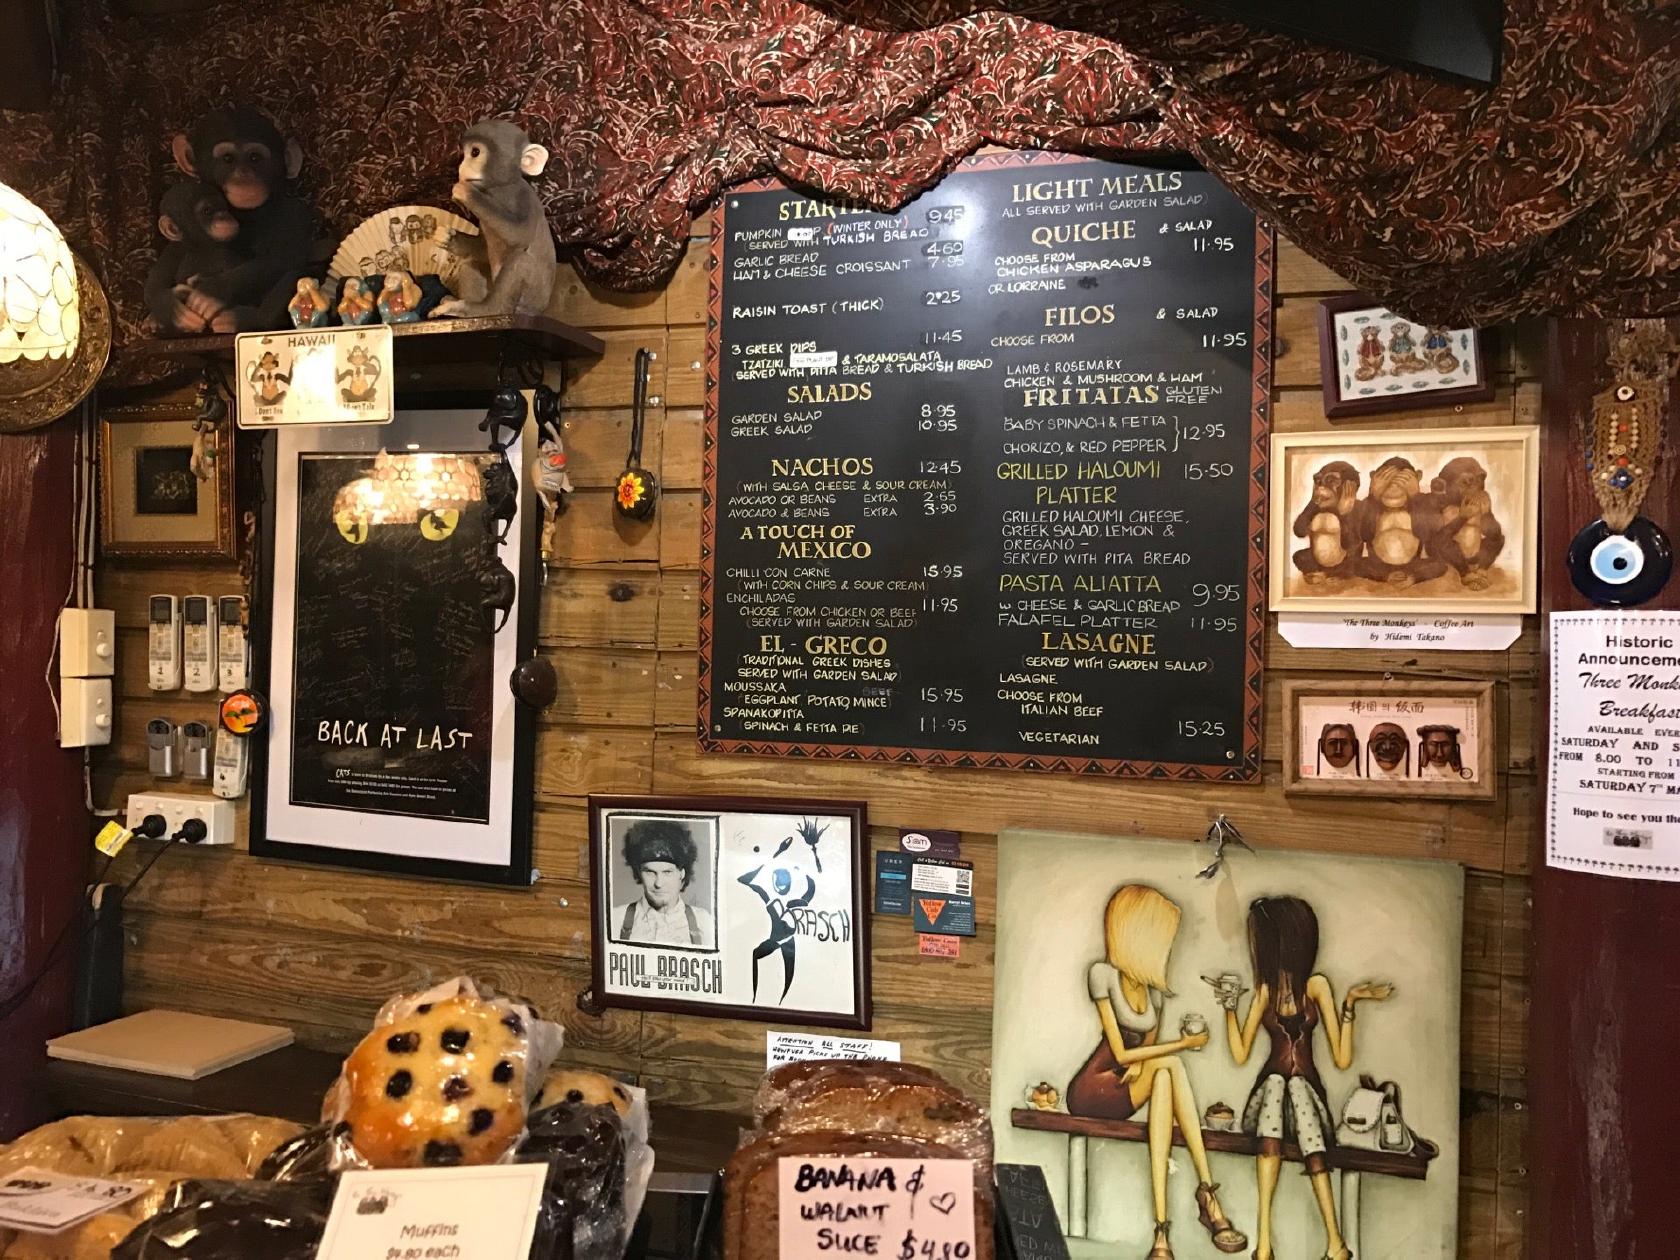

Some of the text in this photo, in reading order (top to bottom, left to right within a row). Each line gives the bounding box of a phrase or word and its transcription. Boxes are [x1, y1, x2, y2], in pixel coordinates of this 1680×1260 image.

[1012, 172, 1182, 203] LIGHT MEALS
[1026, 199, 1157, 216] SERVED WITH GARDEN
[1175, 220, 1213, 232] SALAD
[735, 229, 781, 242] PUMPKIN
[823, 233, 874, 246] TURKISH
[884, 228, 929, 242] BREAD
[1032, 220, 1136, 248] QUICHE
[734, 253, 818, 268] GARLIC BREAD
[995, 252, 1075, 266] CHOOSE FROM
[734, 260, 911, 280] HAM CHEESE CROISSANT
[998, 256, 1151, 277] CHICKEN ASPARAGUS
[1008, 279, 1066, 293] LORRAINE
[733, 299, 884, 319] RAISIN TOAST (THICK)
[1176, 307, 1218, 319] SALAD
[1045, 305, 1115, 327] FILOS
[288, 335, 335, 347] HAWAII
[746, 341, 816, 355] GREEK DIPS
[854, 351, 941, 364] TARAMOSALATA
[742, 360, 784, 370] TZATZIKI
[898, 359, 953, 373] TURKISH
[1007, 362, 1040, 374] LAMB
[1055, 360, 1122, 373] ROSEMARY
[1004, 376, 1054, 388] CHICKEN
[1078, 373, 1152, 385] MUSHROOM
[787, 382, 872, 404] SALADS
[1023, 385, 1159, 407] FRITATAS
[1166, 386, 1222, 395] GLUTEN
[1166, 395, 1208, 404] FREE
[732, 414, 778, 424] GARDEN
[1004, 416, 1105, 431] BABY SPINACH
[1122, 416, 1166, 426] FETTA
[731, 426, 768, 437] GREEK
[1080, 439, 1166, 453] RED PEPPER
[772, 458, 873, 476] NACHOS
[997, 460, 1160, 480] GRILLED HALOUMI
[773, 481, 856, 491] SALSA CHEESE
[728, 495, 836, 505] AVOCADO OR BEANS
[864, 494, 898, 503] EXTRA
[1036, 486, 1117, 504] PLATTER
[728, 508, 776, 518] AVOCADO
[1003, 510, 1058, 523] GRILLED
[1063, 510, 1122, 522] HALOUMI
[758, 525, 855, 539] TOUCH OF
[1106, 525, 1153, 536] LEMON
[777, 542, 871, 559] MEXICO
[1004, 539, 1074, 550] OREGANO
[1105, 553, 1133, 564] PITA
[726, 568, 830, 578] CHILLI CON CARNE
[771, 581, 837, 590] CORN CHIPS
[1000, 574, 1162, 593] PASTA ALIATTA
[727, 593, 796, 603] ENCHILADAS
[1088, 600, 1136, 612] GARLIC
[999, 614, 1157, 628] FALAFEL PLATTER
[761, 635, 784, 653] EL
[805, 635, 887, 655] GRECO
[1042, 632, 1156, 654] LASAGNE
[1606, 635, 1673, 648] Historic
[853, 658, 891, 668] DISHES
[1000, 673, 1058, 684] LASAGNE
[1579, 672, 1680, 690] Three Monk
[724, 682, 786, 693] MOUSSAKA
[854, 697, 887, 708] MINCE
[724, 708, 804, 719] SPANAKOPITTA
[1021, 705, 1103, 717] ITALIAN BEEF
[318, 720, 473, 750] BACK AT LAST
[1588, 726, 1643, 735] AVAILABLE
[1019, 732, 1099, 745] VEGETARIAN
[1561, 737, 1659, 751] SATURDAY AND
[1560, 752, 1583, 761] FROM
[1636, 757, 1652, 766] TO
[1598, 768, 1646, 778] STARTING
[1580, 780, 1646, 792] SATURDAY
[1573, 808, 1599, 818] Hope
[1602, 810, 1613, 819] to
[1642, 815, 1662, 823] you
[794, 1164, 896, 1192] BANANA
[400, 1224, 458, 1239] Muffins
